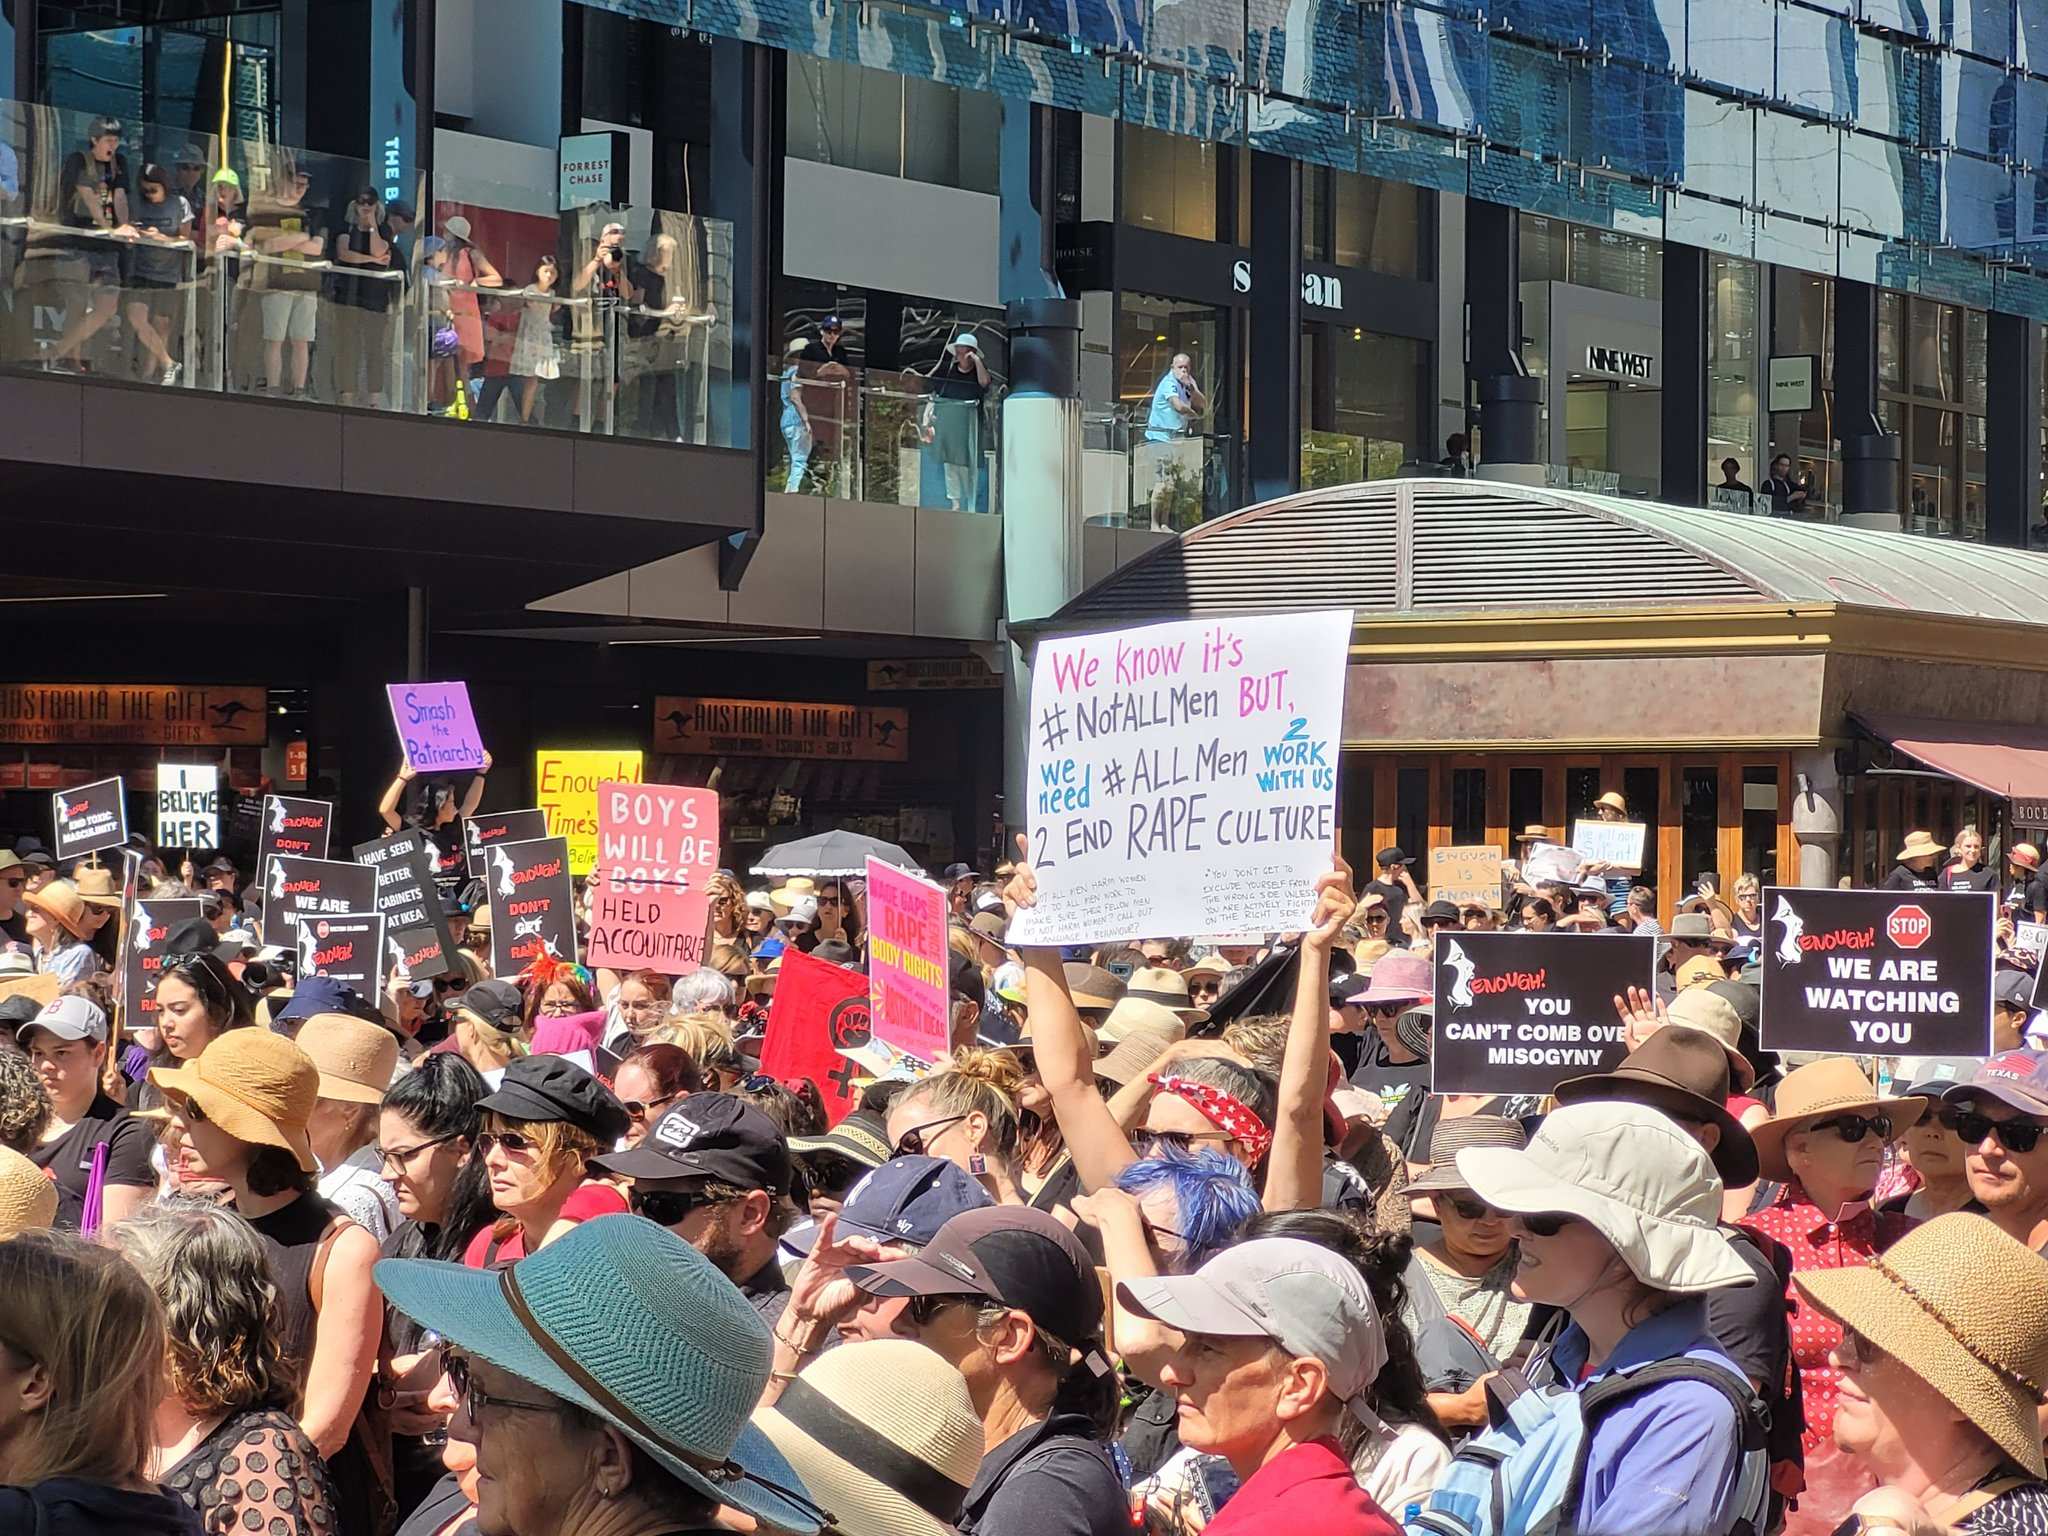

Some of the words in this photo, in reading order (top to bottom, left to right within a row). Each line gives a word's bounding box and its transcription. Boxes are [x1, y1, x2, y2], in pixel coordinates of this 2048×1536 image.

[384, 136, 399, 179] THE
[563, 159, 609, 172] FORREST
[569, 173, 603, 185] CHASE
[1588, 346, 1619, 373] NINE
[1619, 352, 1653, 378] WEST
[1052, 648, 1100, 694] We
[1203, 626, 1244, 673] it's
[119, 690, 155, 721] THE
[165, 690, 208, 721] GIFT
[1239, 669, 1295, 718] BUT,
[405, 692, 456, 724] Smash
[694, 703, 792, 735] AUSTRALIA
[800, 709, 829, 737] THE
[432, 723, 450, 736] the
[1281, 717, 1311, 742] 2
[407, 738, 484, 766] Patriarchy
[1263, 740, 1328, 768] WORK
[180, 769, 186, 789] I
[1039, 763, 1091, 815] need
[1312, 766, 1334, 792] US
[159, 790, 218, 813] BELIEVE
[610, 792, 698, 829] BOYS
[541, 804, 598, 835] Time's
[1034, 826, 1056, 870] 2
[1066, 818, 1113, 860] END
[1127, 793, 1208, 861] RAPE
[1217, 804, 1333, 846] CULTURE
[161, 820, 214, 849] HER
[276, 838, 311, 851] DON'T
[364, 848, 388, 865] HAVE
[390, 840, 414, 857] SEEN
[568, 848, 597, 864] Belie
[604, 832, 669, 865] WILL
[679, 835, 714, 866] BE
[1435, 851, 1497, 863] ENOUGH
[378, 867, 412, 887] BETTER
[511, 859, 562, 885] ENOUGH!
[610, 866, 689, 895] BOYS
[1457, 869, 1473, 880] IS
[295, 895, 318, 910] WE
[320, 898, 350, 913] ARE
[378, 887, 423, 910] CABINETS
[510, 899, 551, 916] DON'T
[602, 898, 661, 924] HELD
[901, 891, 928, 920] GAPS
[1202, 895, 1220, 905] THE
[1224, 892, 1255, 901] WRONG
[387, 914, 400, 929] AT
[400, 908, 424, 927] IKEA
[1220, 912, 1240, 921] THE
[1245, 910, 1271, 919] RIGHT
[1890, 918, 1927, 935] STOP
[885, 905, 927, 956] RAPE
[1800, 927, 1875, 951] ENOUGH!
[591, 927, 707, 963] ACCOUNTABLE
[871, 936, 900, 969] BODY
[902, 951, 944, 989] RIGHTS
[1827, 957, 1871, 980] WE
[1879, 960, 1938, 982] ARE
[1470, 968, 1547, 994] ENOUGH!
[1524, 998, 1571, 1015] YOU
[1805, 987, 1960, 1014] WATCHING
[1445, 1023, 1512, 1041] CAN'T
[1516, 1024, 1581, 1042] COMB
[1587, 1025, 1626, 1043] OVE
[1850, 1020, 1912, 1044] YOU
[1488, 1048, 1603, 1066] MISOGYNY
[1986, 1068, 2020, 1081] TEXAS
